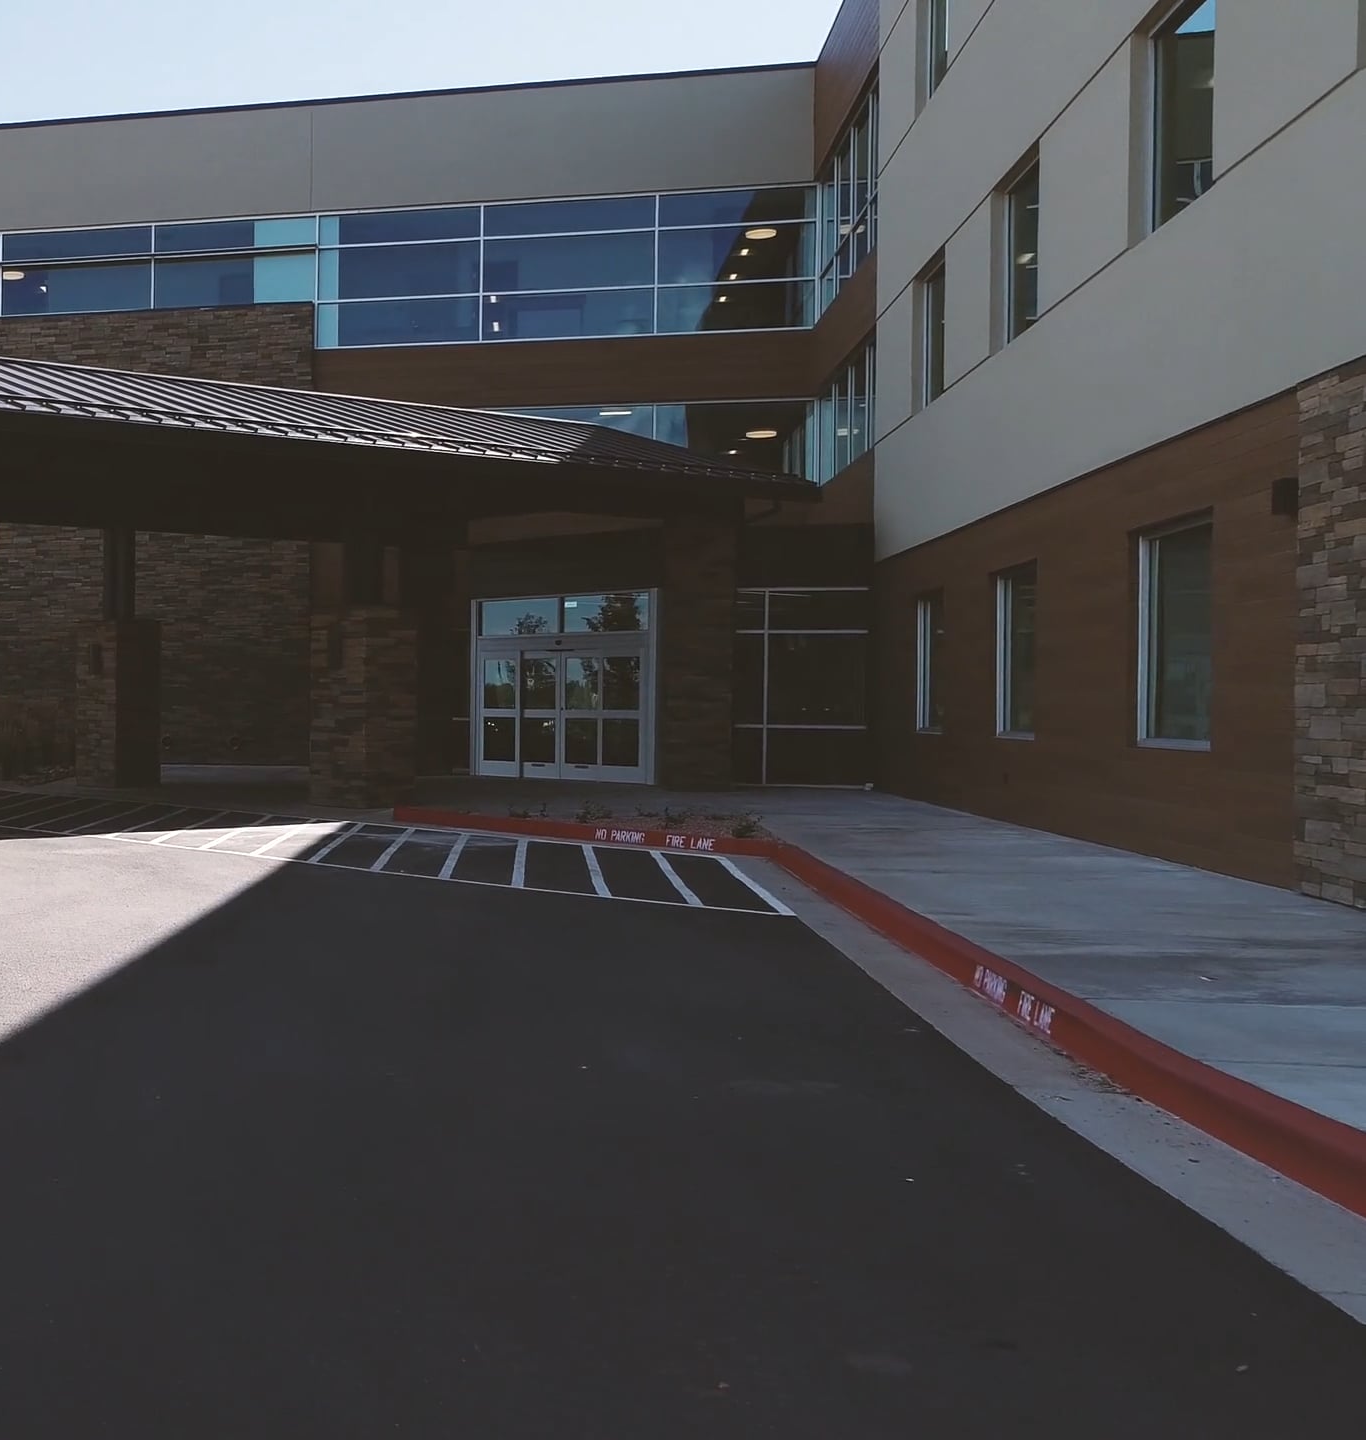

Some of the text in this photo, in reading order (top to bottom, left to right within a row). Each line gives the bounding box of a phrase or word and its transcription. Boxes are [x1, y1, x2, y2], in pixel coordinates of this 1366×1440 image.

[594, 828, 716, 851] NO PARKING FIRE LANE
